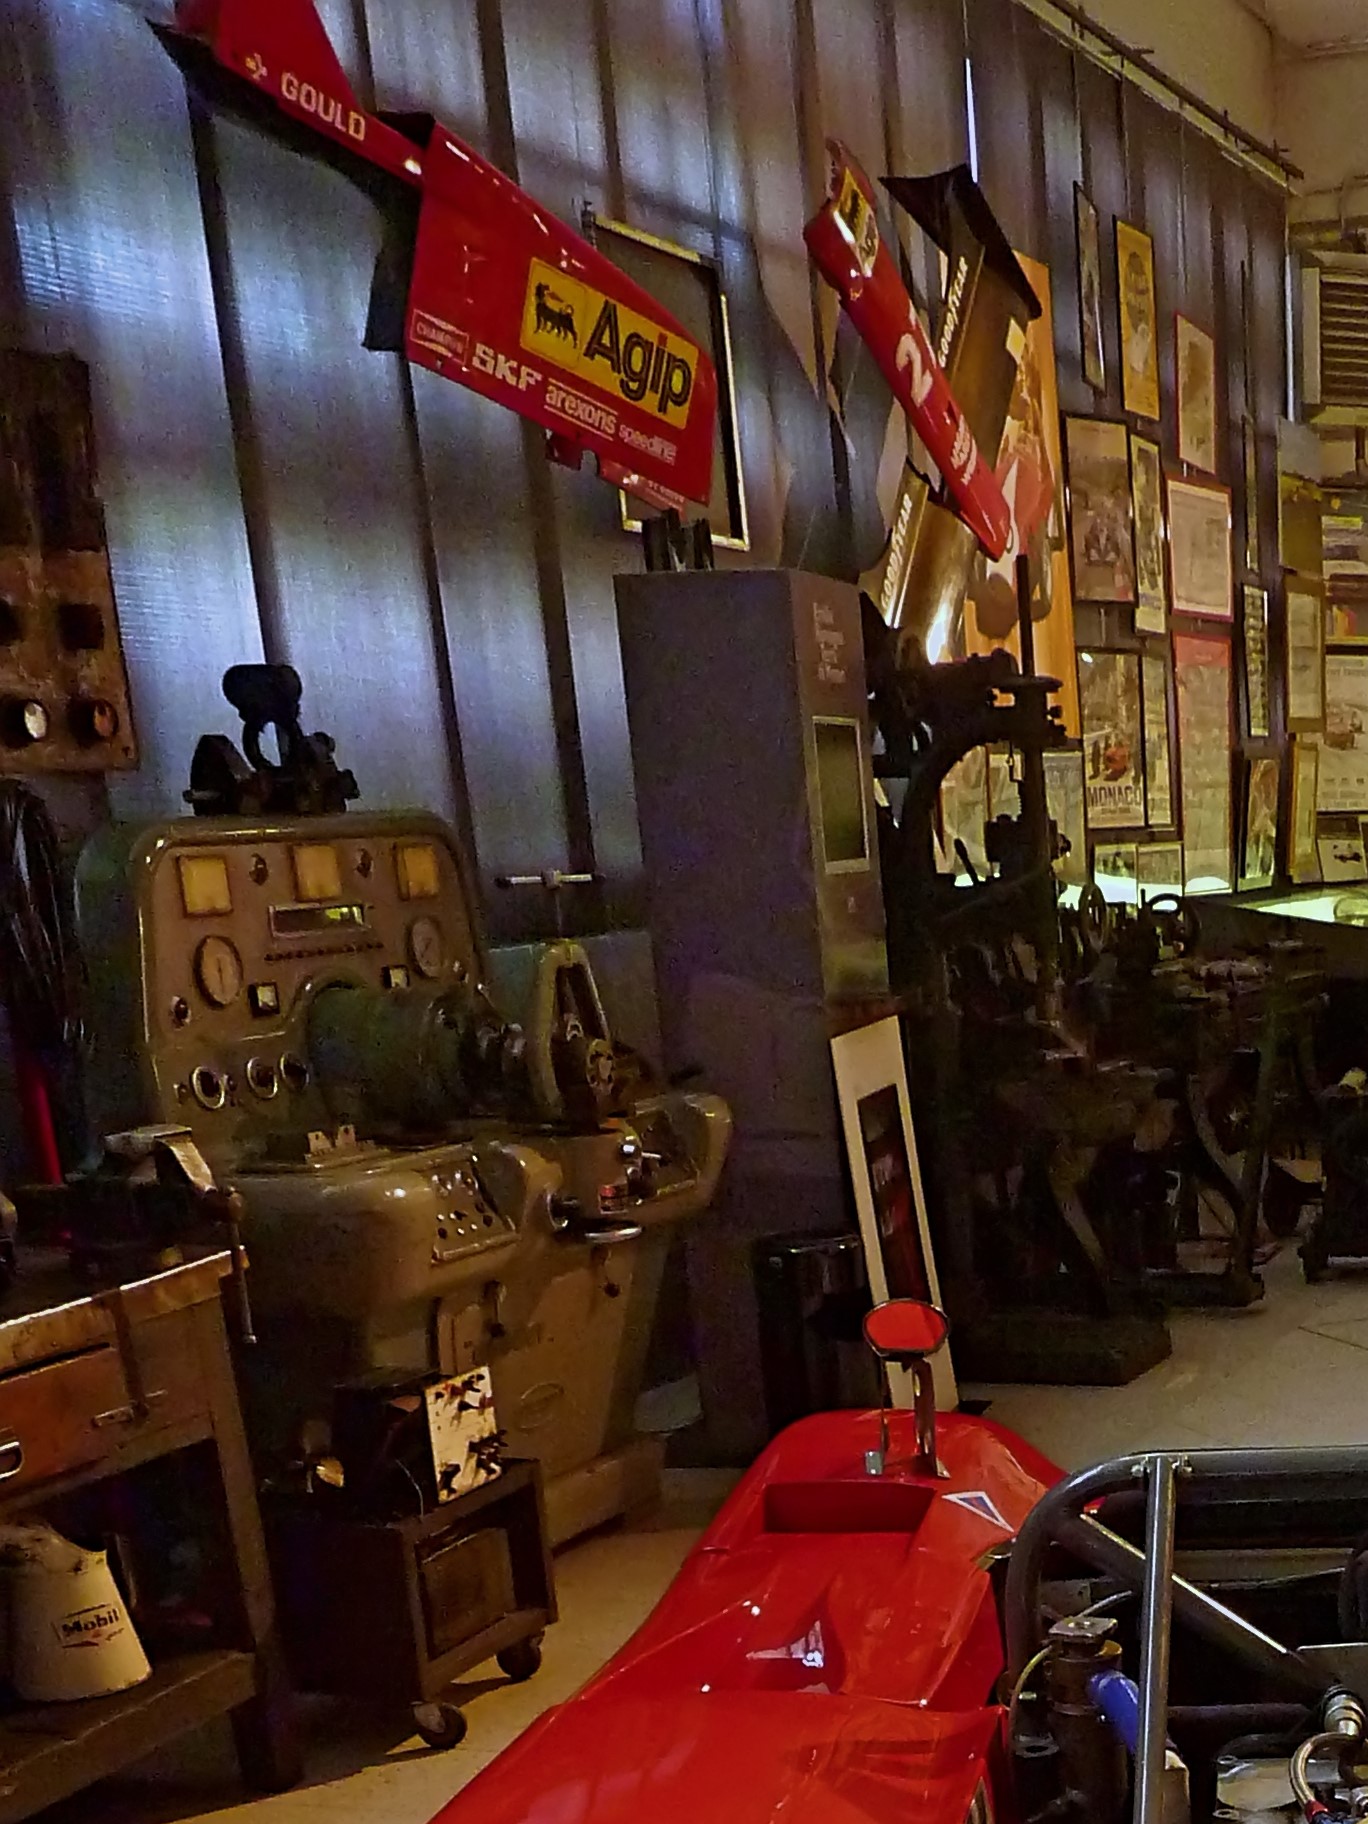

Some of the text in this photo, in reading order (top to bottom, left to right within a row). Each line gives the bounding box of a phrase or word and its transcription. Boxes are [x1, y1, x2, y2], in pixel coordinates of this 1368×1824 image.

[280, 71, 367, 142] GOULD
[938, 255, 969, 368] GOODYEAR
[472, 342, 543, 392] SKF
[583, 299, 692, 415] Agip
[896, 333, 934, 408] 2
[545, 384, 618, 435] arexons
[881, 493, 913, 610] GOODYEAR
[1087, 784, 1142, 808] MONACO
[62, 1608, 119, 1634] Mobil
